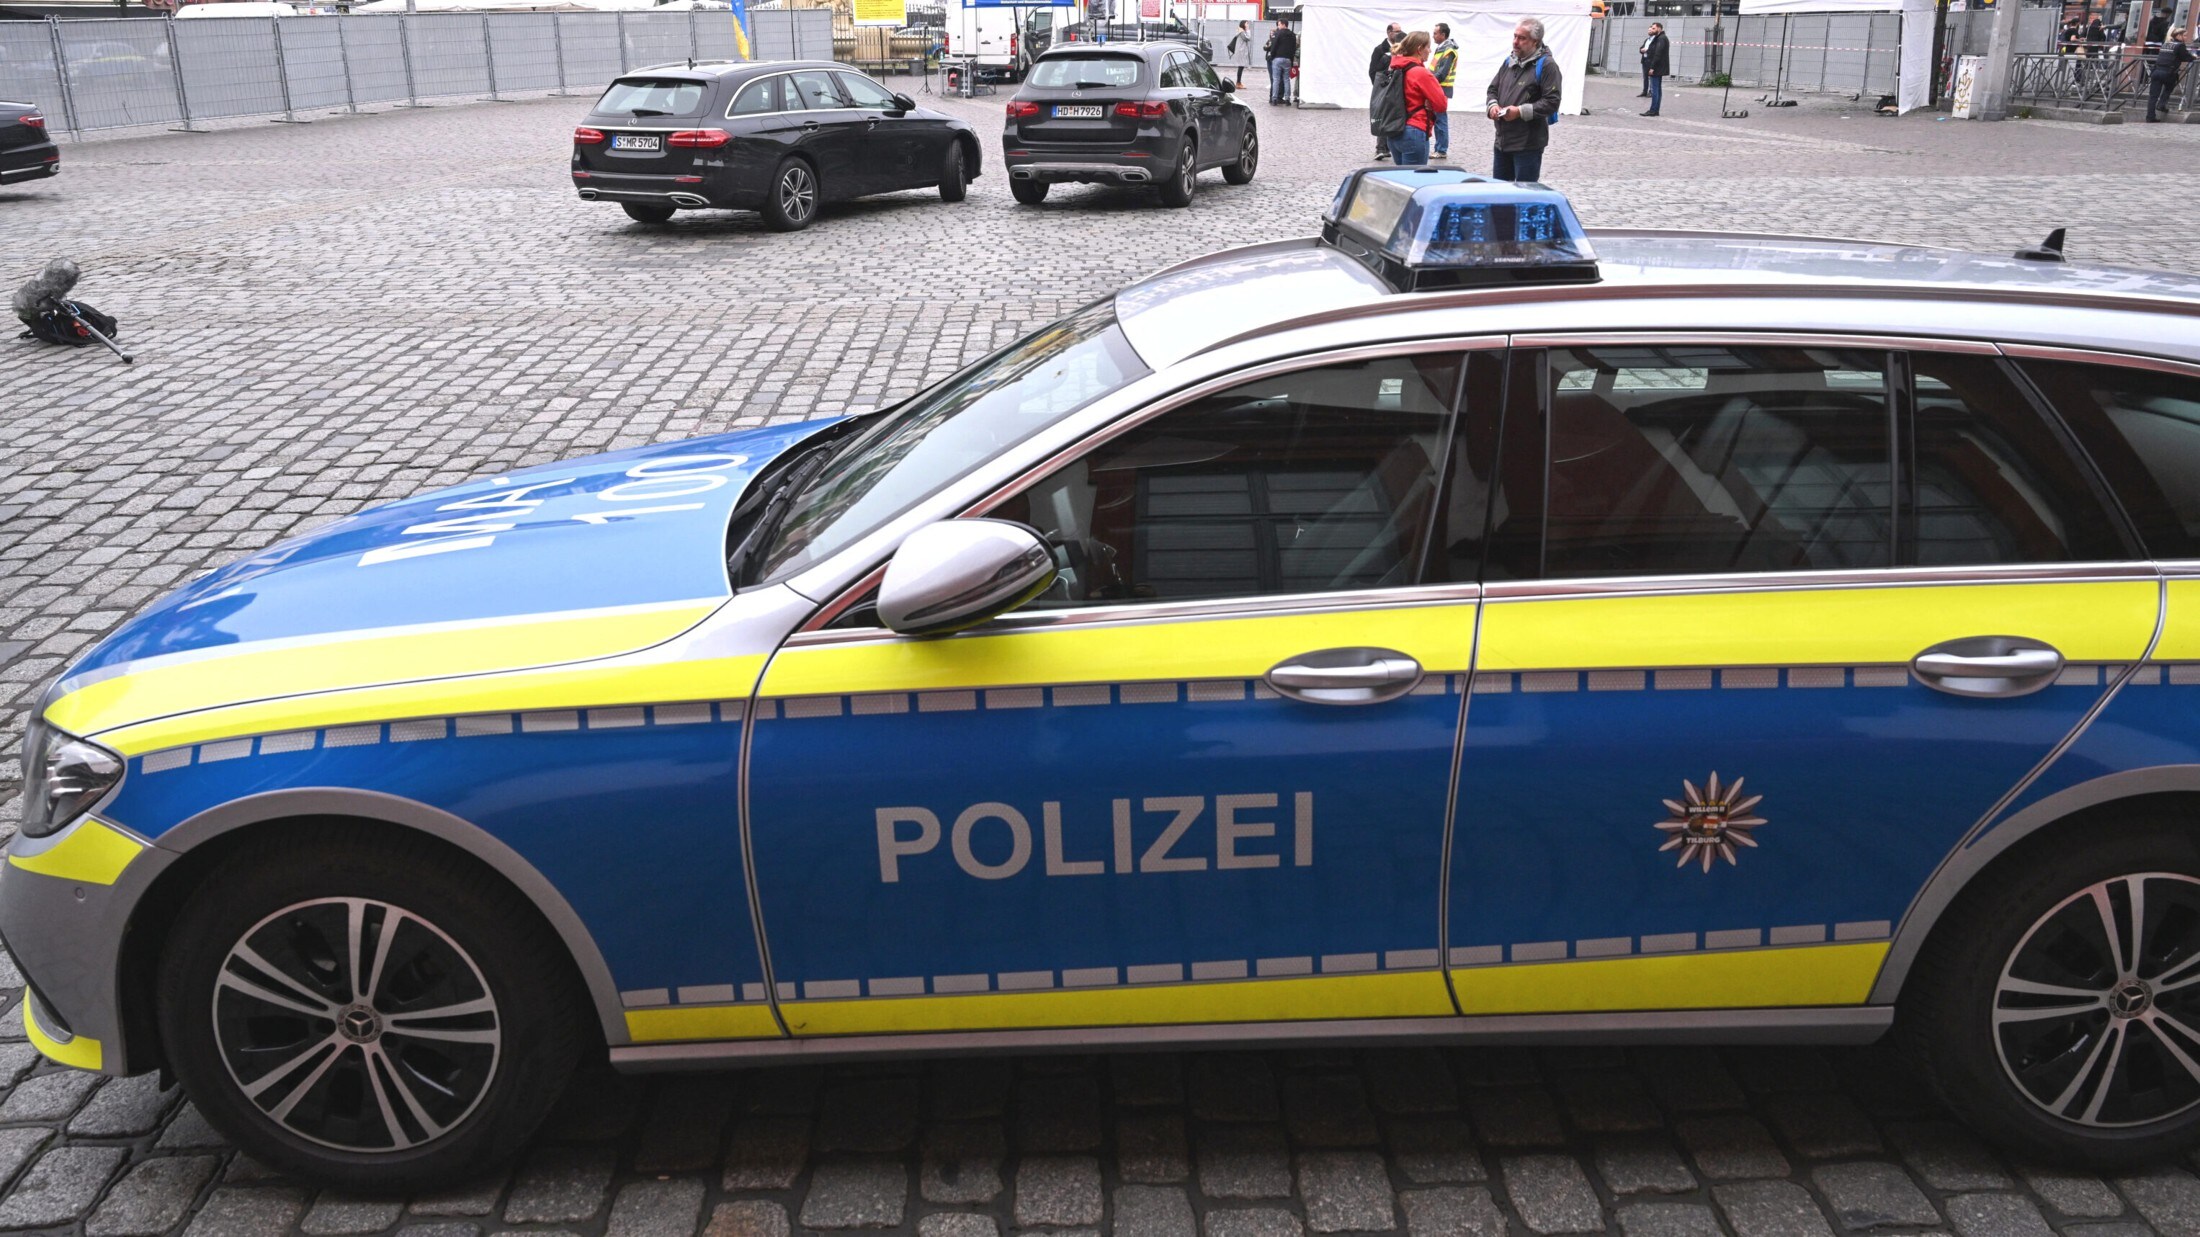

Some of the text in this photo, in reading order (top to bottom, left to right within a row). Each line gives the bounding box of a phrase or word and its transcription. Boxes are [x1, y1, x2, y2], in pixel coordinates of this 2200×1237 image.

[1057, 107, 1101, 116] HD H 7926
[616, 137, 658, 148] S MR 5704
[570, 454, 749, 524] 100
[875, 791, 1313, 883] POLIZEI
